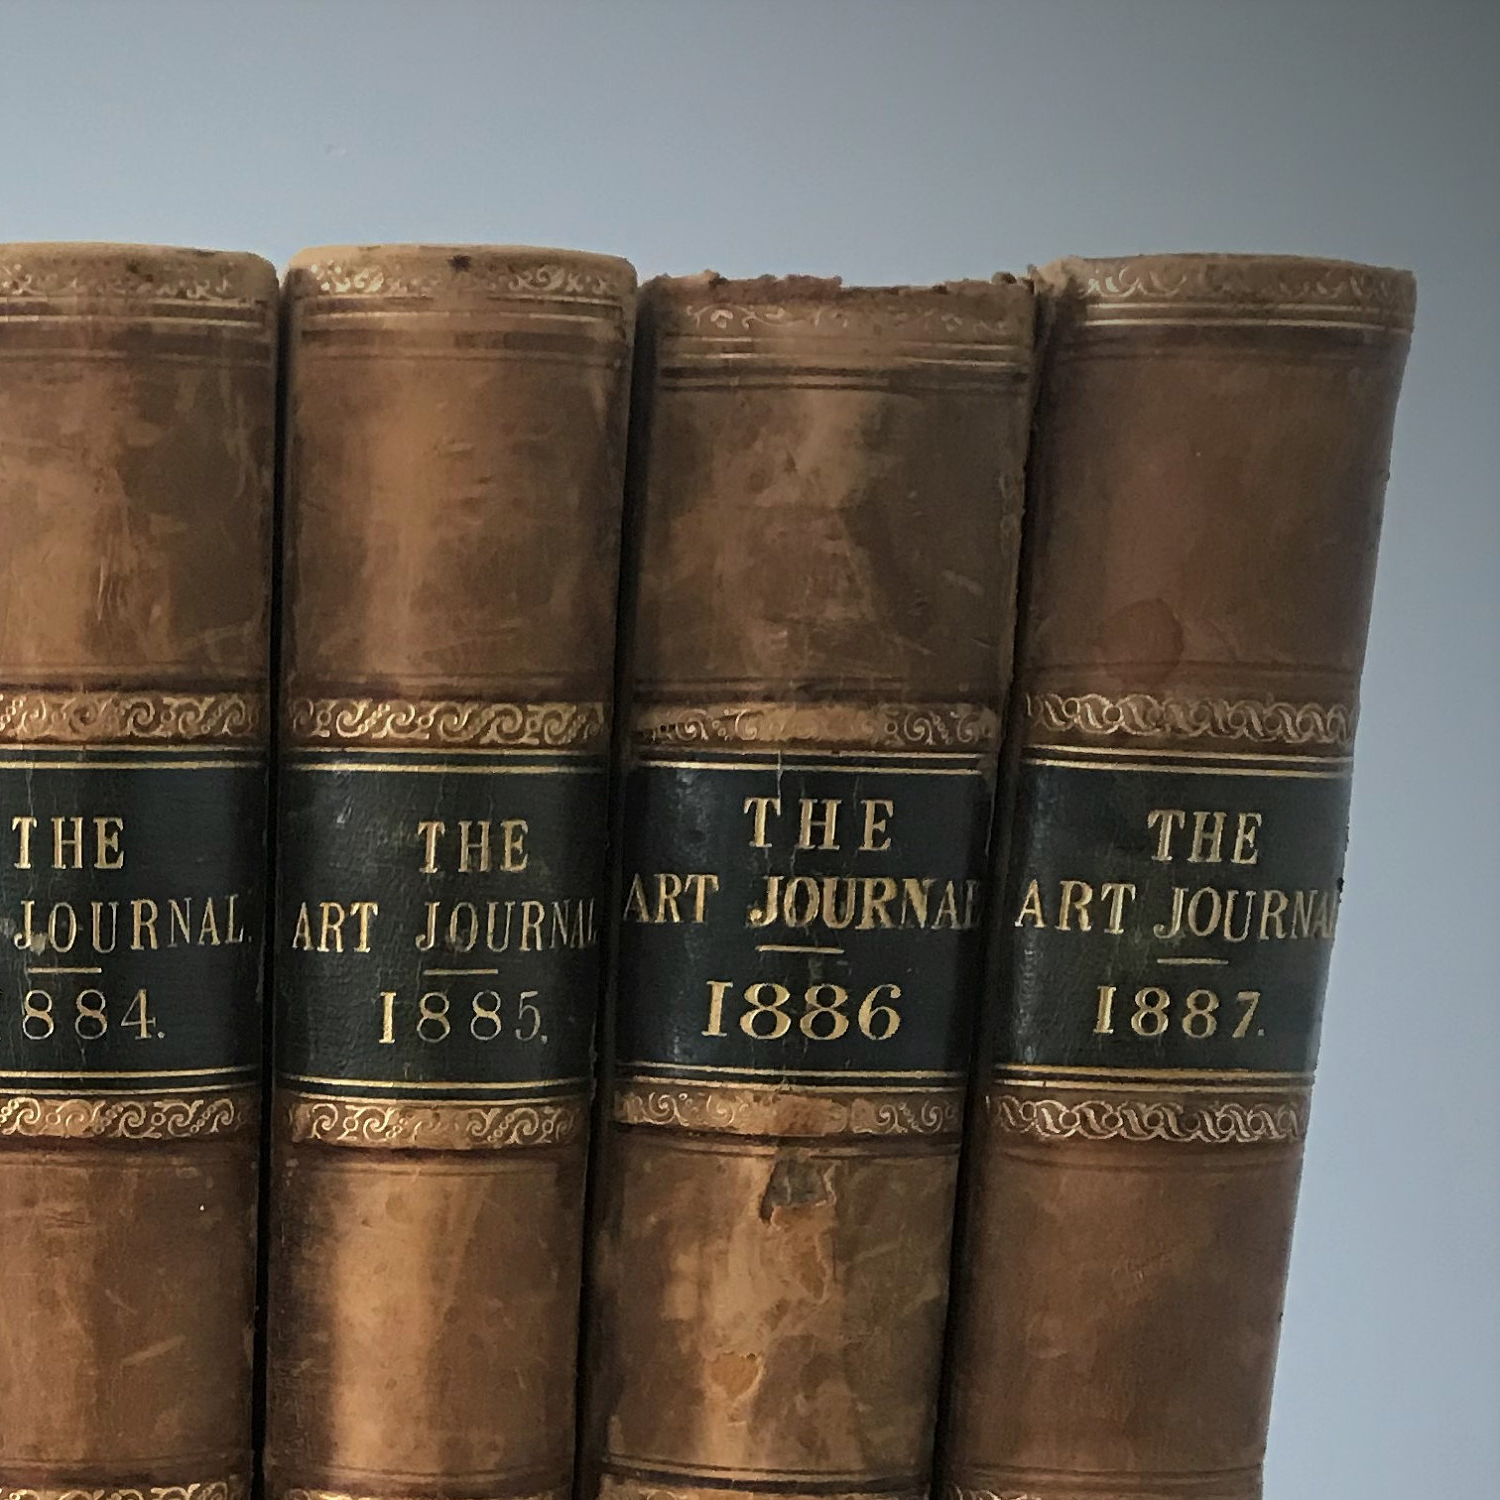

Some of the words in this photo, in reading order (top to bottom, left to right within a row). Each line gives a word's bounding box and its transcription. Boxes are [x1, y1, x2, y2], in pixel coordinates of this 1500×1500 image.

[11, 815, 125, 871] THE
[417, 819, 529, 874] THE
[742, 796, 895, 852] THE
[1146, 808, 1263, 865] THE
[12, 893, 253, 954] JOURNAL.
[622, 872, 720, 924] ART
[1014, 878, 1137, 935] ART
[291, 901, 380, 954] ART
[378, 990, 549, 1045] 1885.
[701, 980, 902, 1041] 1886
[1092, 984, 1266, 1039] 1887.
